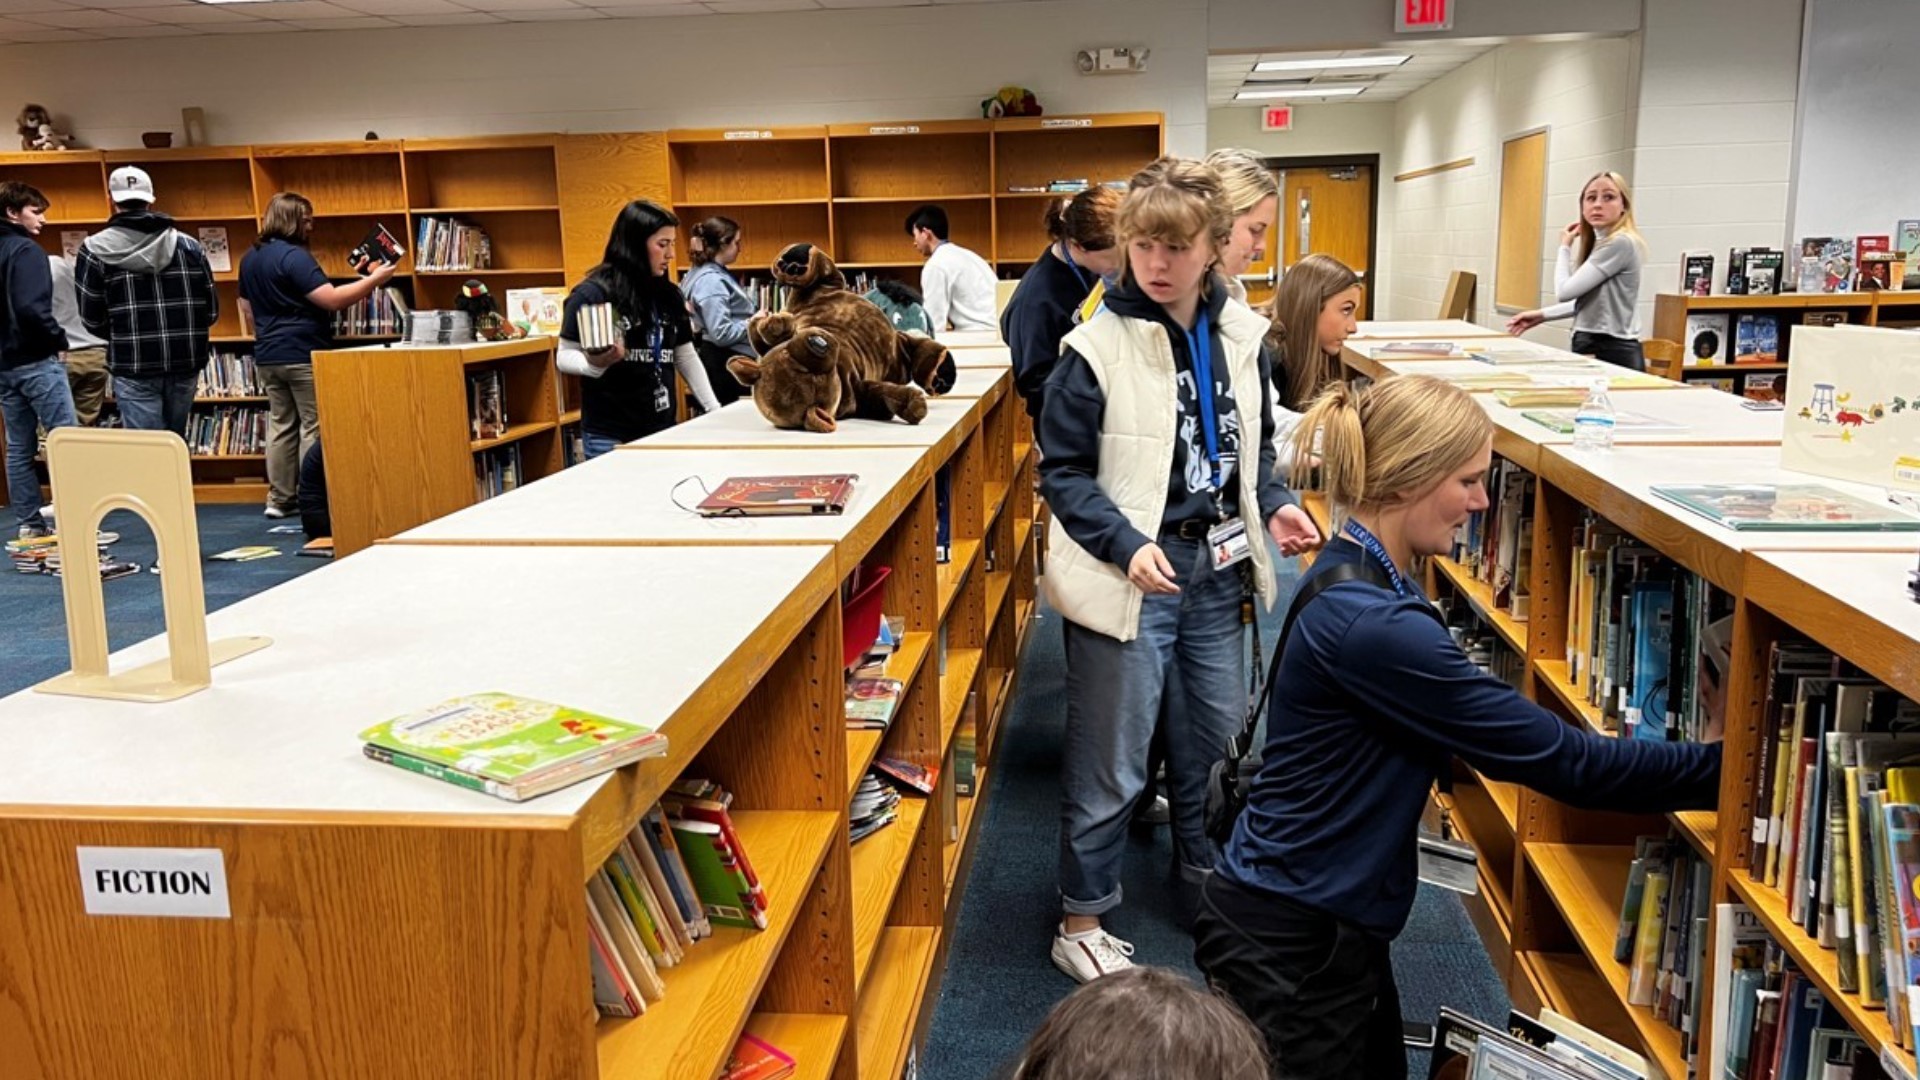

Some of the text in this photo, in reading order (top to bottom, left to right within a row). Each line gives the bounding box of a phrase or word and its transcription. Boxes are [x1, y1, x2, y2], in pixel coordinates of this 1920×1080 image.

[1267, 109, 1288, 127] EXIT
[126, 176, 137, 188] P
[95, 869, 211, 895] FICTION
